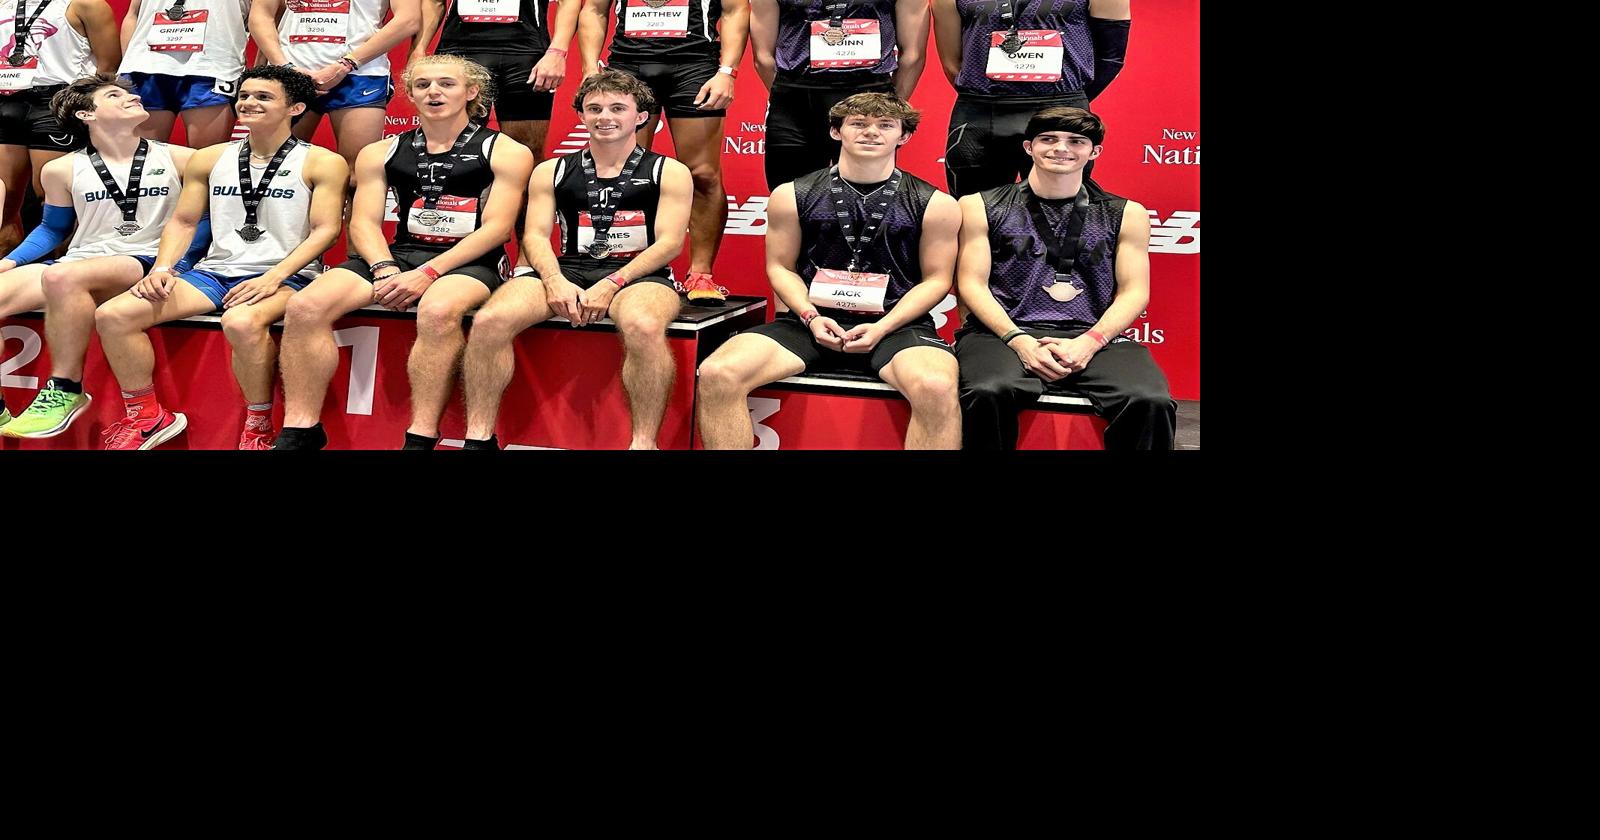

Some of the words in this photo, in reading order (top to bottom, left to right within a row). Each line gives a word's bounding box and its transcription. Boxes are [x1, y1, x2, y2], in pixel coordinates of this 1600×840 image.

[385, 115, 408, 126] New
[740, 121, 767, 133] New
[1162, 128, 1196, 140] New
[832, 289, 862, 298] JACK
[0, 325, 42, 390] 2
[333, 325, 380, 416] 1
